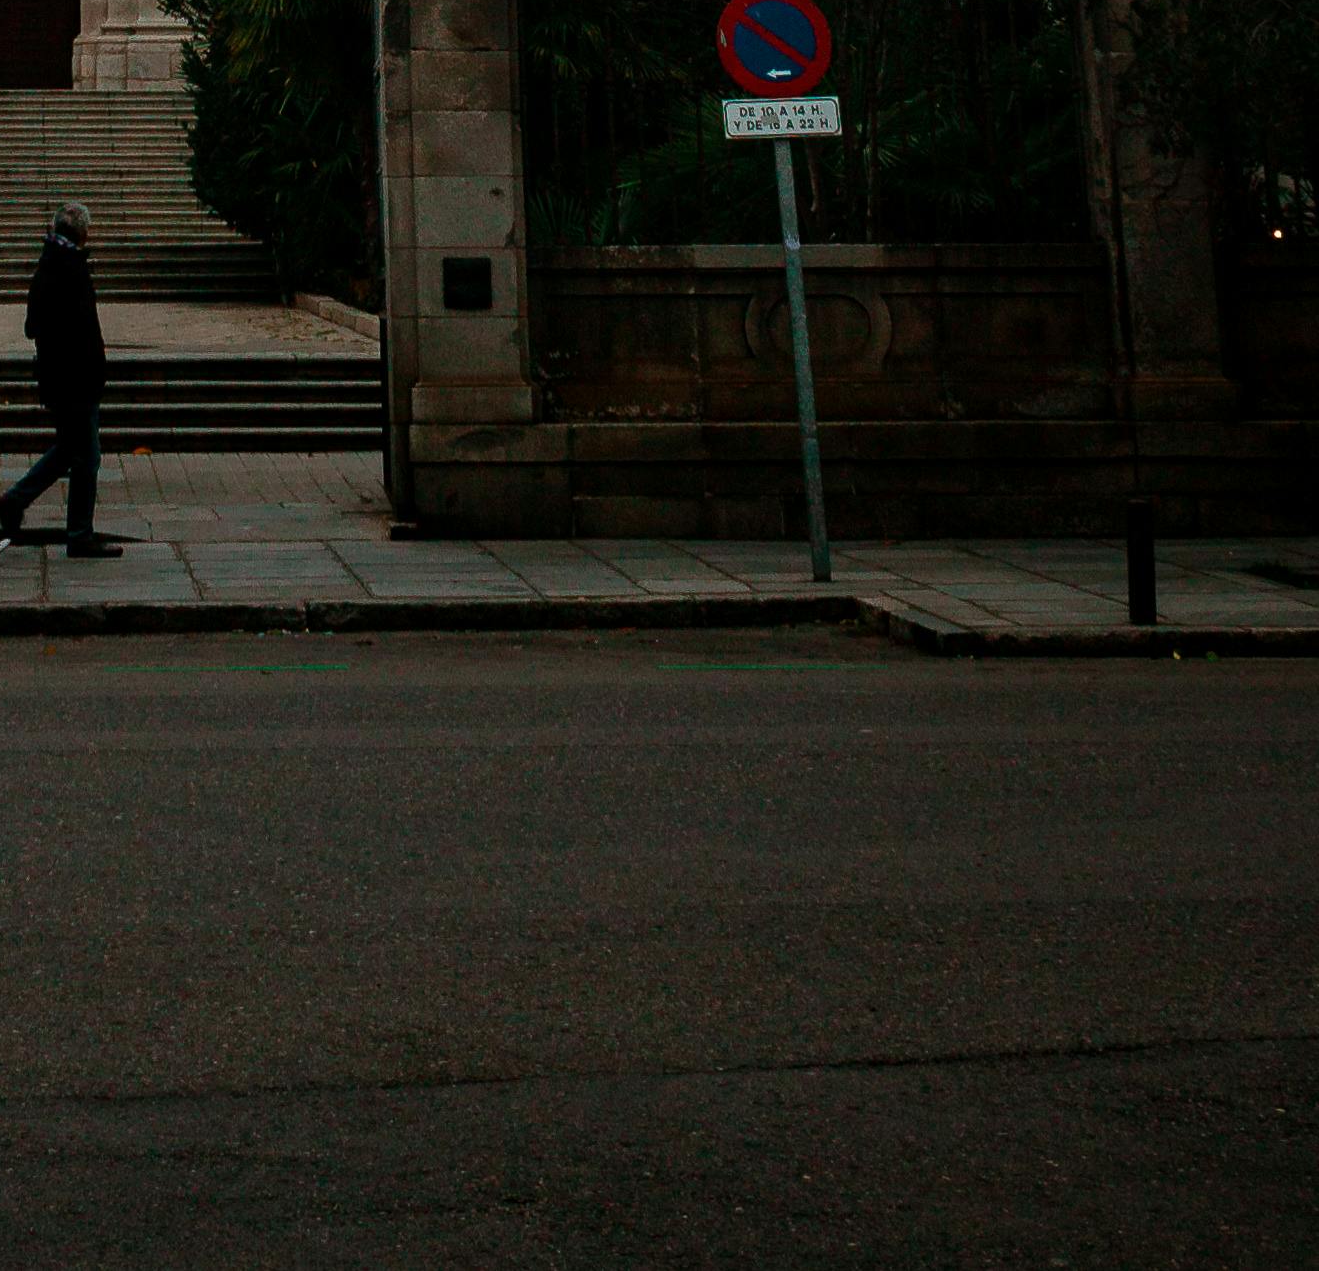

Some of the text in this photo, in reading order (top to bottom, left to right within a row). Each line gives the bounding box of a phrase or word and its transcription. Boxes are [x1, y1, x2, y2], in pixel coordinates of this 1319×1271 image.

[739, 107, 756, 117] DE
[779, 106, 788, 116] A
[792, 106, 805, 116] 14
[733, 121, 741, 130] Y
[747, 120, 763, 130] DE
[786, 119, 794, 129] A
[799, 119, 815, 129] 22
